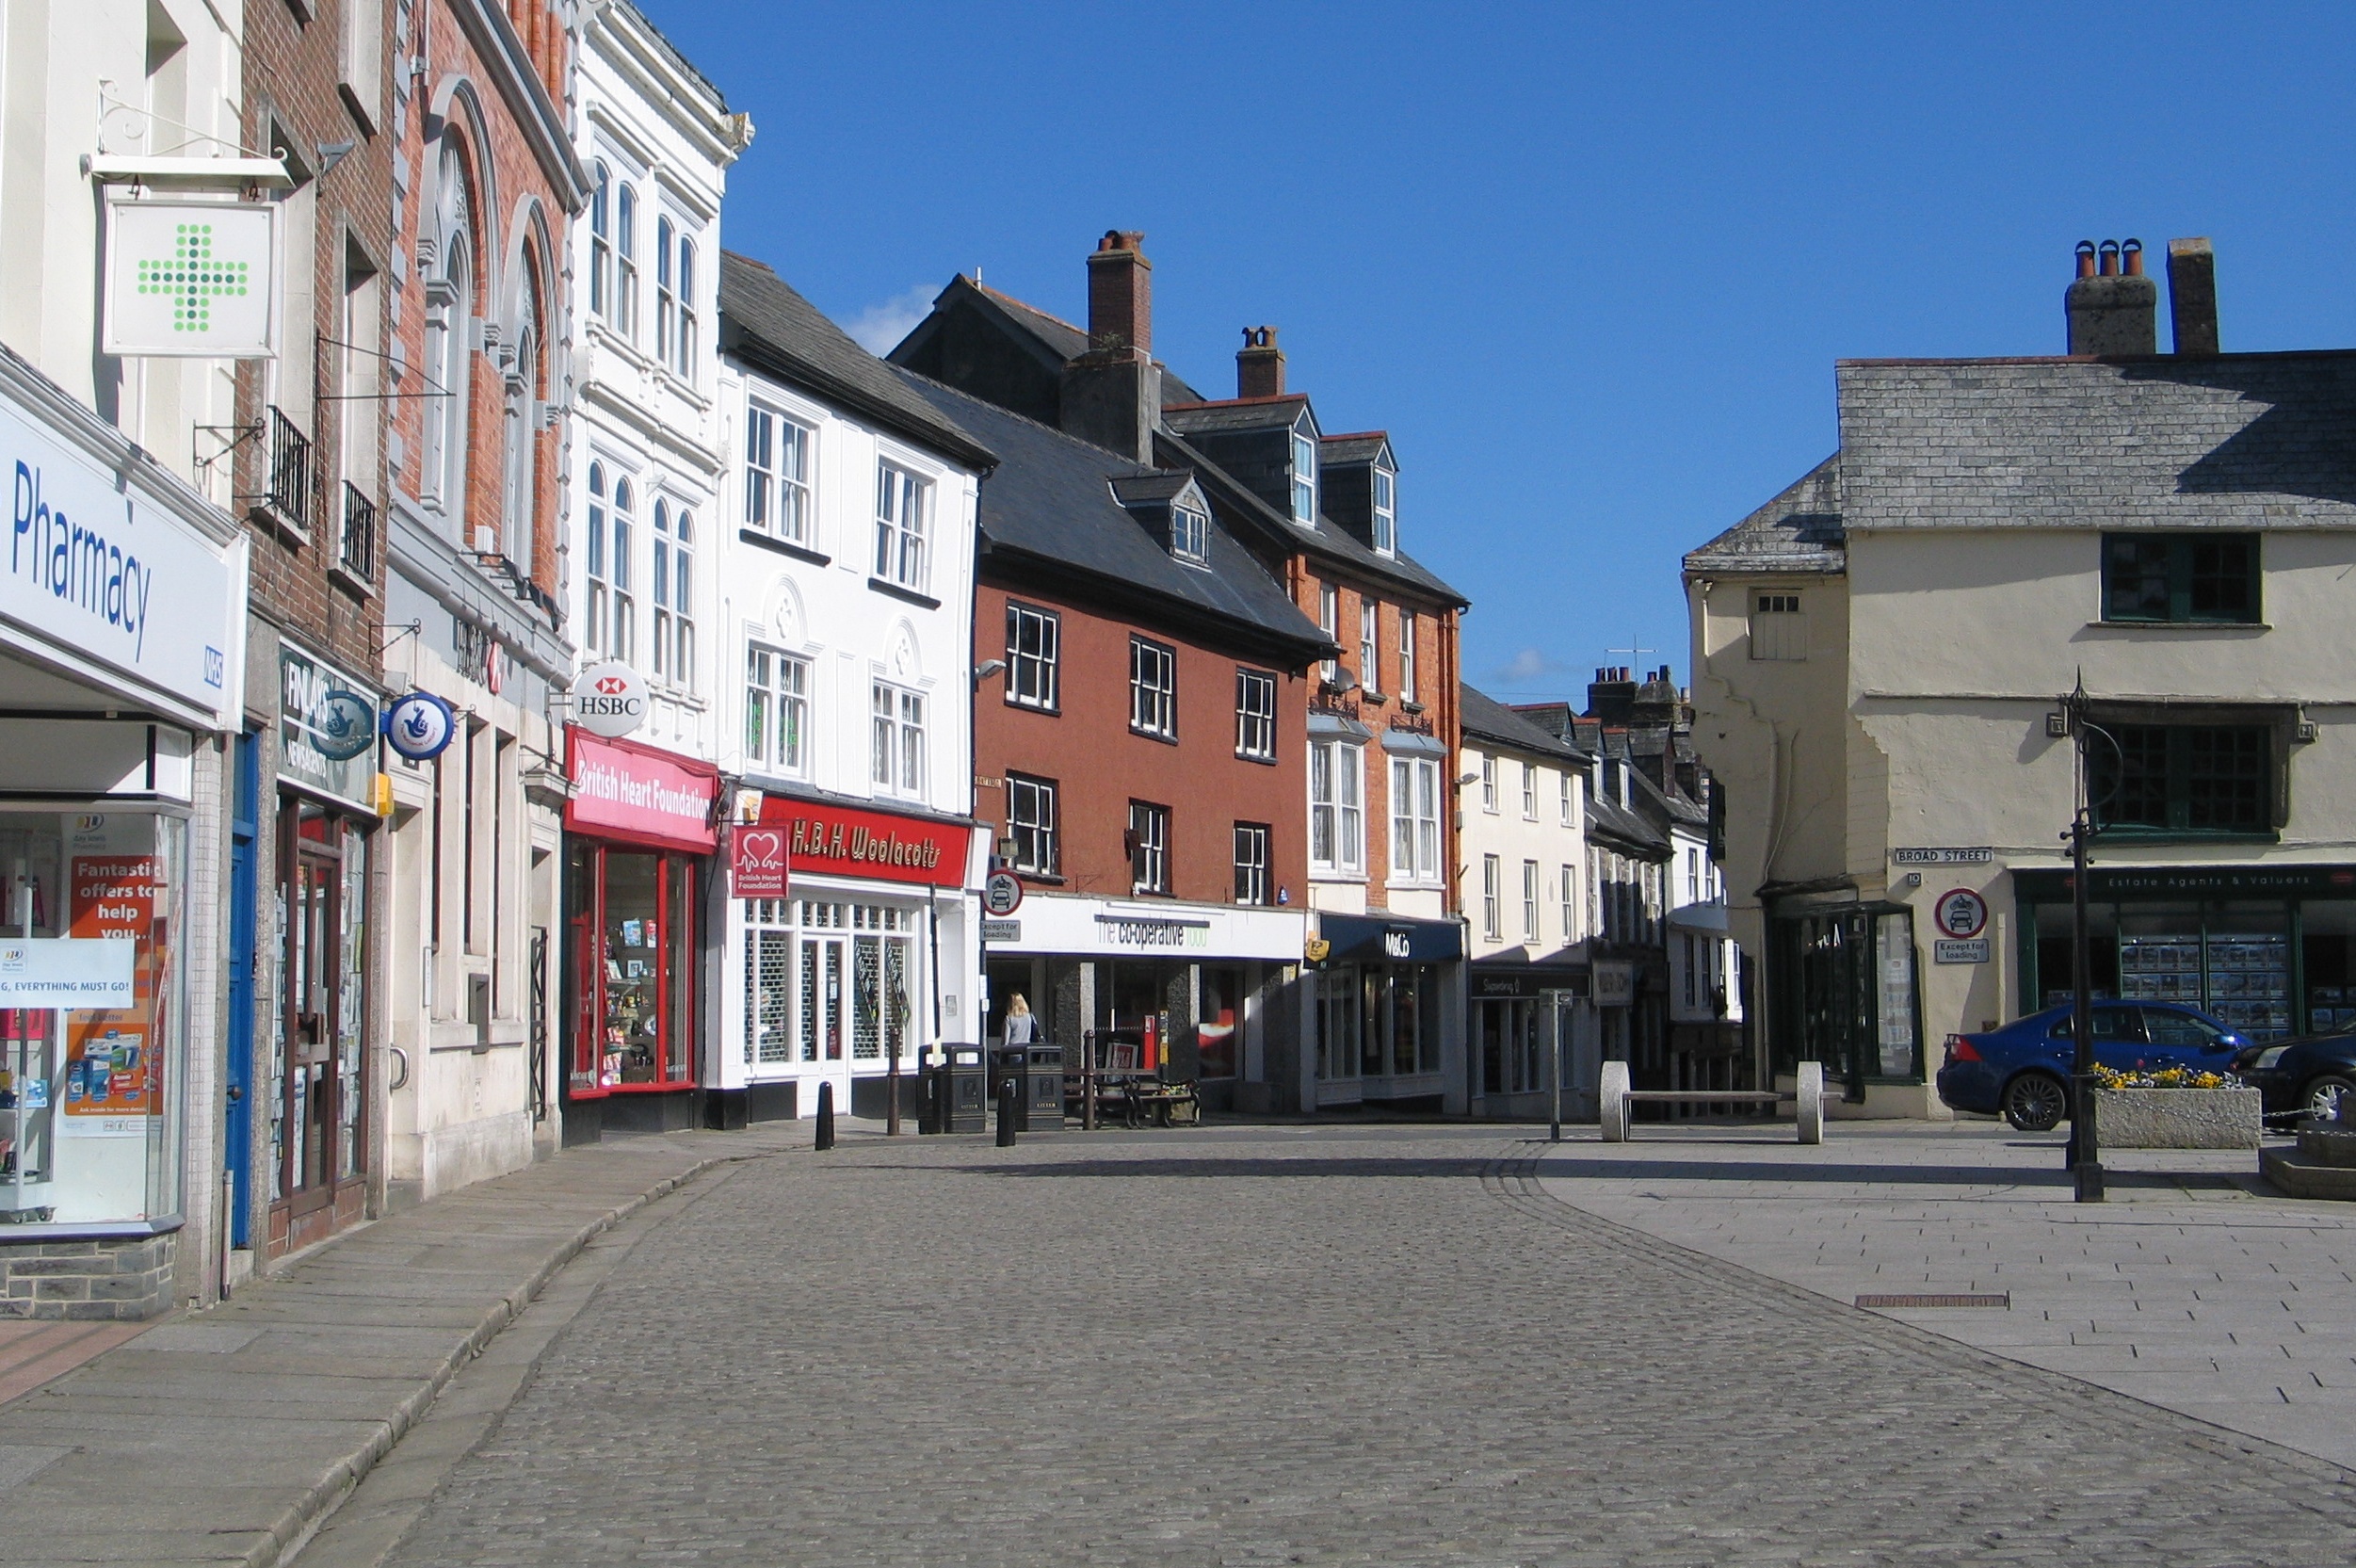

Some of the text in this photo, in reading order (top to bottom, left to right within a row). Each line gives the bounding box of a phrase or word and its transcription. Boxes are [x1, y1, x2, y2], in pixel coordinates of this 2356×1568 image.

[13, 459, 151, 663] Pharmacy
[204, 648, 222, 687] NHS
[287, 661, 329, 724] FINLAYS
[579, 696, 641, 716] HSBC
[287, 738, 327, 779] NEWSAGENTS
[577, 760, 711, 821] British Heart Foundation
[791, 817, 941, 869] H.B.H. Woolacotts
[1898, 850, 1989, 862] BROAD STREET
[78, 861, 162, 877] Fantastic
[738, 874, 761, 882] British
[738, 881, 782, 890] Foundation
[2108, 875, 2310, 888] Estate Agents & Valuers
[80, 883, 157, 897] offers to
[98, 904, 138, 922] help
[1006, 922, 1018, 930] for
[983, 930, 1012, 939] loading
[1119, 921, 1184, 950] co-operative
[1385, 932, 1411, 958] M&Co
[1940, 944, 1970, 952] Except
[1945, 951, 1977, 960] loading
[15, 982, 77, 991] EVERYTHING
[80, 982, 107, 991] MUST
[111, 982, 129, 991] GO!
